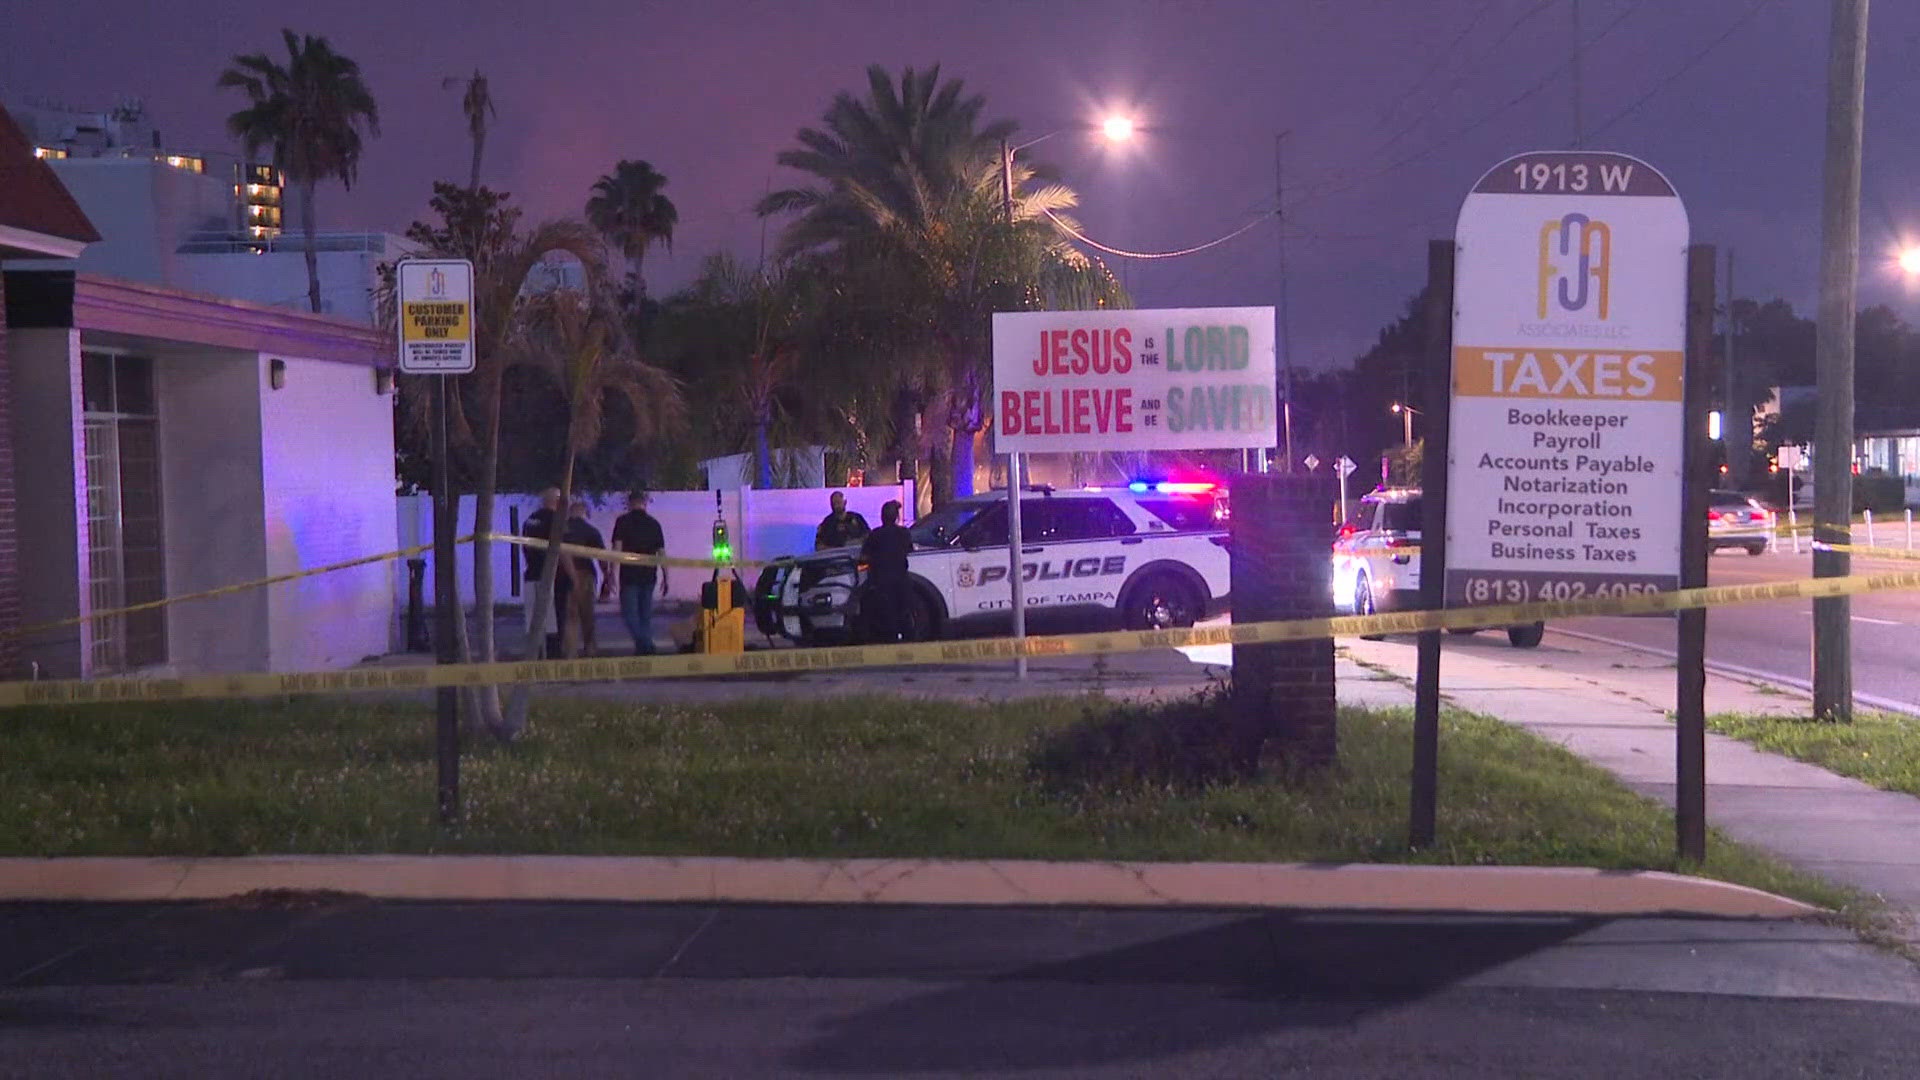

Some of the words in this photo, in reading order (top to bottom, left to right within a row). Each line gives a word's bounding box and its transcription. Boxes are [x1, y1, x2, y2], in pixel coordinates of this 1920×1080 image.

[1514, 163, 1588, 191] 1913
[1600, 164, 1633, 192] W
[408, 303, 465, 316] CUSTOMER
[414, 315, 460, 327] PARKING
[424, 327, 450, 338] ONLY
[1032, 327, 1133, 376] JESUS
[1144, 338, 1154, 349] IS
[1166, 325, 1250, 373] LORD
[1140, 353, 1159, 365] THE
[1482, 352, 1656, 396] TAXES
[1001, 388, 1133, 436] BELIEVE
[1141, 400, 1161, 410] AND
[1145, 415, 1157, 426] BE
[1507, 408, 1629, 431] Bookkeeper
[1533, 432, 1601, 453] Payroll
[1478, 453, 1569, 471] Accounts
[1576, 455, 1655, 475] Payable
[1503, 475, 1628, 495] Notarization
[1498, 497, 1632, 519] Incorporation
[1488, 519, 1573, 538] Personal
[1586, 521, 1641, 539] Taxes
[1491, 542, 1575, 560] Business
[1582, 544, 1637, 562] Taxes
[976, 555, 1127, 588] POLICE
[978, 600, 1012, 609] CIT
[1027, 596, 1050, 606] OF
[1057, 591, 1116, 603] TAMPA
[1464, 578, 1530, 604] (813)
